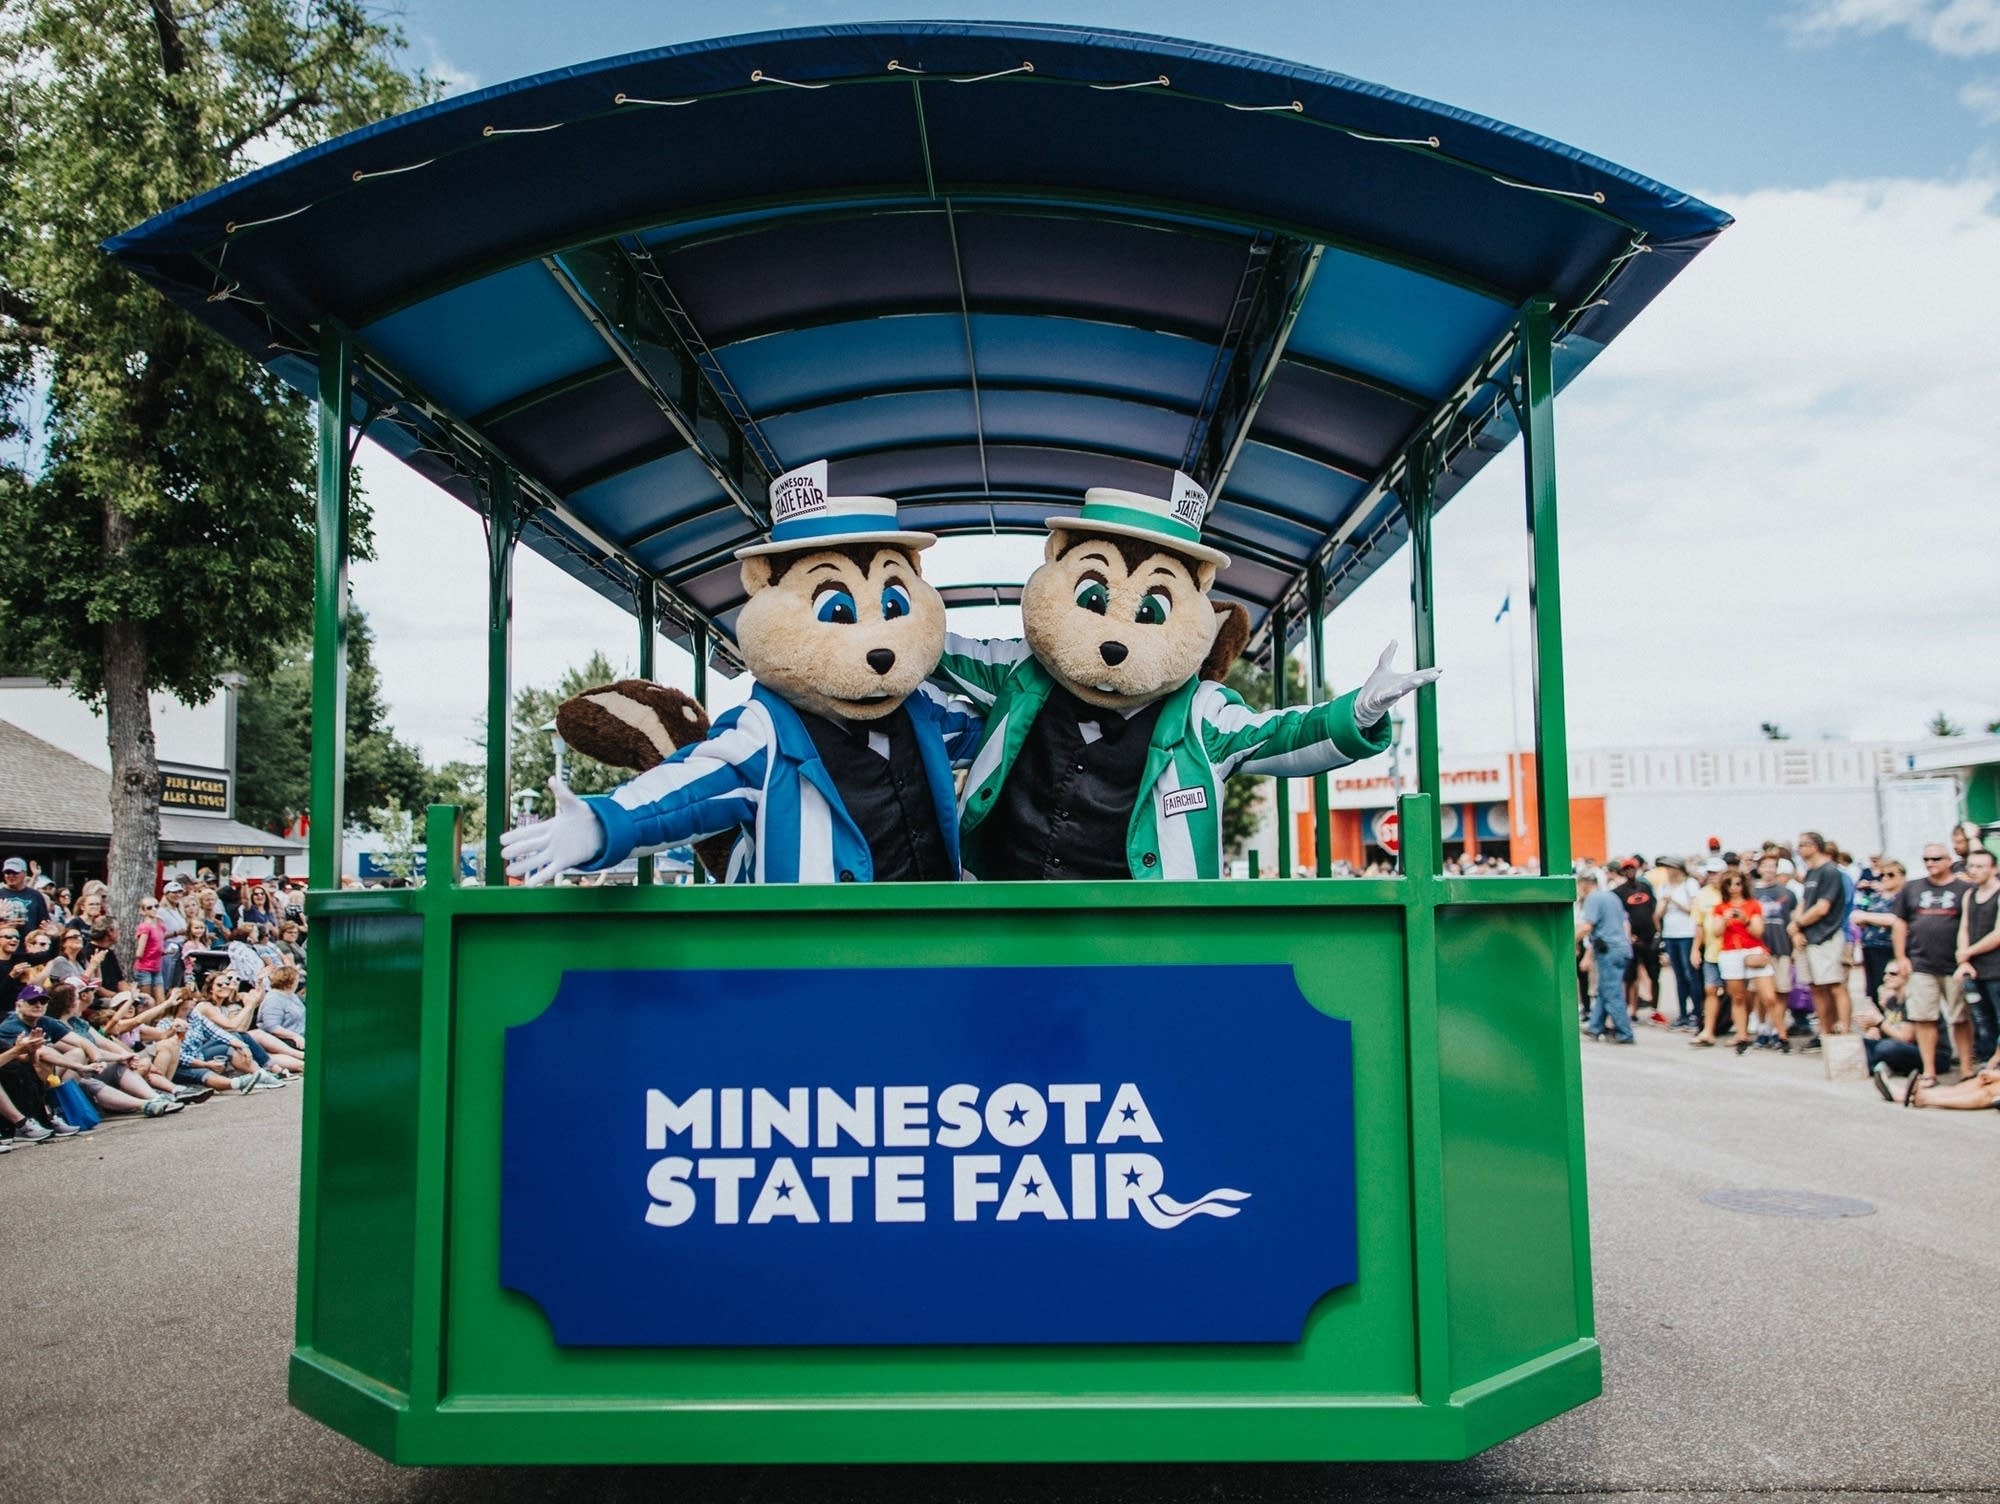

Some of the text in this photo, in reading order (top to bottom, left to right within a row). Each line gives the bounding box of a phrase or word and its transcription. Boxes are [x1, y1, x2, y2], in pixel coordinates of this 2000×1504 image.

[775, 477, 813, 497] MINNESOTA
[776, 487, 824, 517] STATE FAIR
[1175, 500, 1199, 521] STATE
[163, 791, 187, 803] ALES
[189, 794, 196, 804] &
[1165, 791, 1204, 811] FAIRCHILD
[646, 1083, 1163, 1149] MINNESOTA
[645, 1153, 1252, 1229] STATE FAIR
